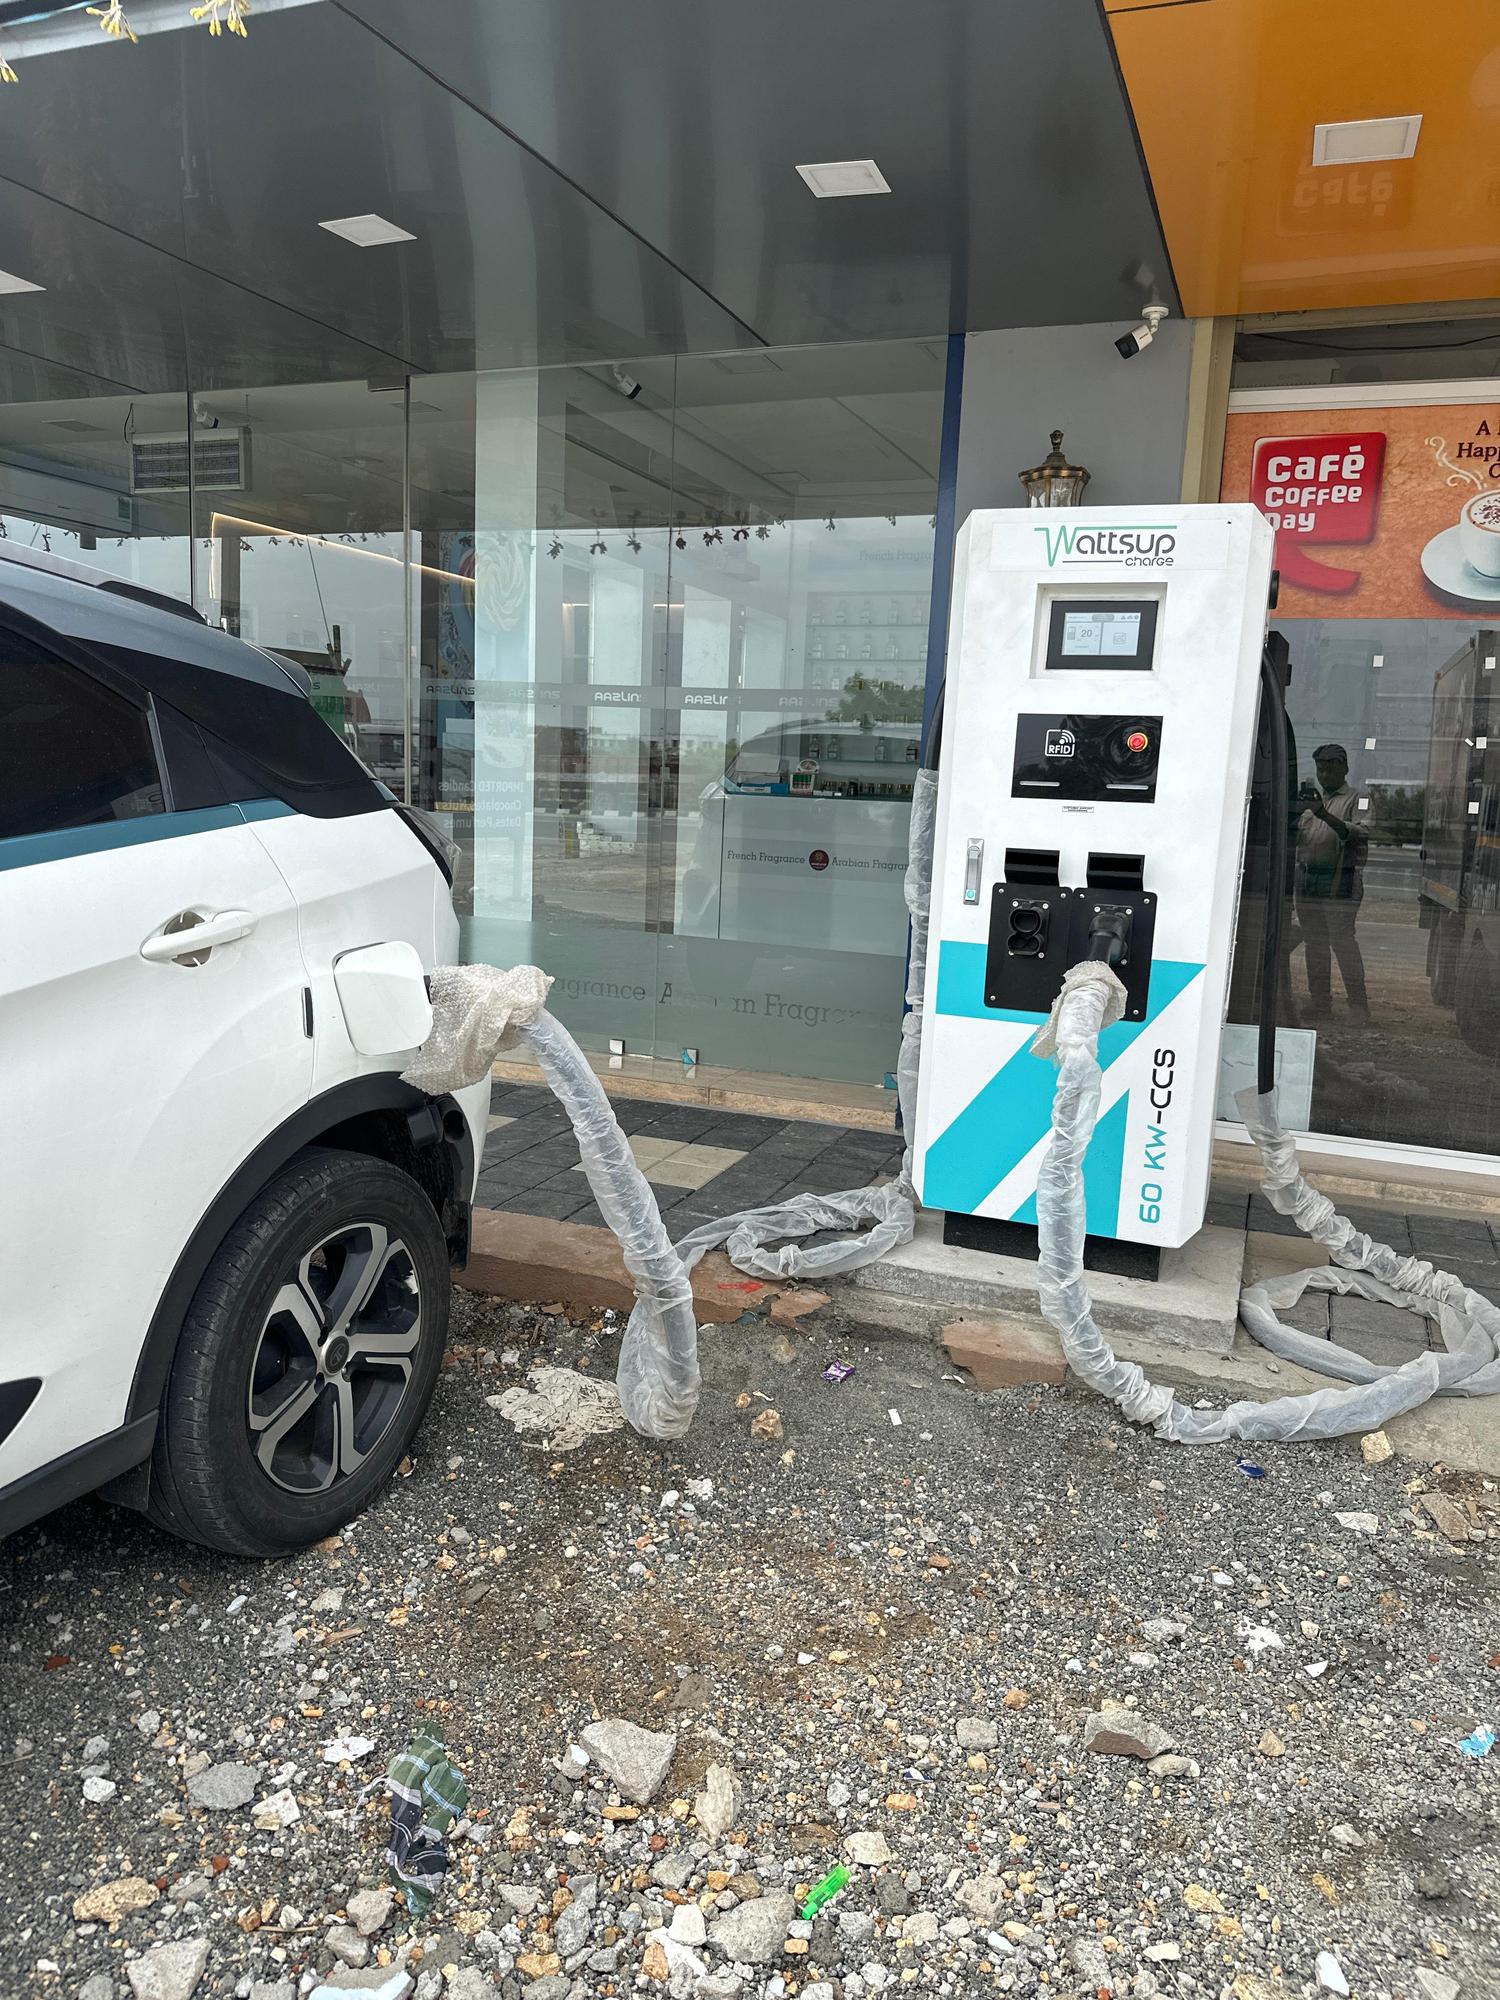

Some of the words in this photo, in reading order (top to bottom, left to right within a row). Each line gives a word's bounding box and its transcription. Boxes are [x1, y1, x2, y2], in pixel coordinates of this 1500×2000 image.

[1475, 420, 1491, 436] A
[1456, 442, 1500, 462] Hap
[1034, 525, 1177, 567] Wattsup
[1080, 629, 1093, 638] 20
[1049, 745, 1072, 754] RFID
[727, 850, 757, 862] French
[759, 852, 806, 865] Fragrance
[831, 857, 870, 869] Arabian
[552, 977, 647, 1001] agrance
[1139, 1182, 1163, 1224] 60
